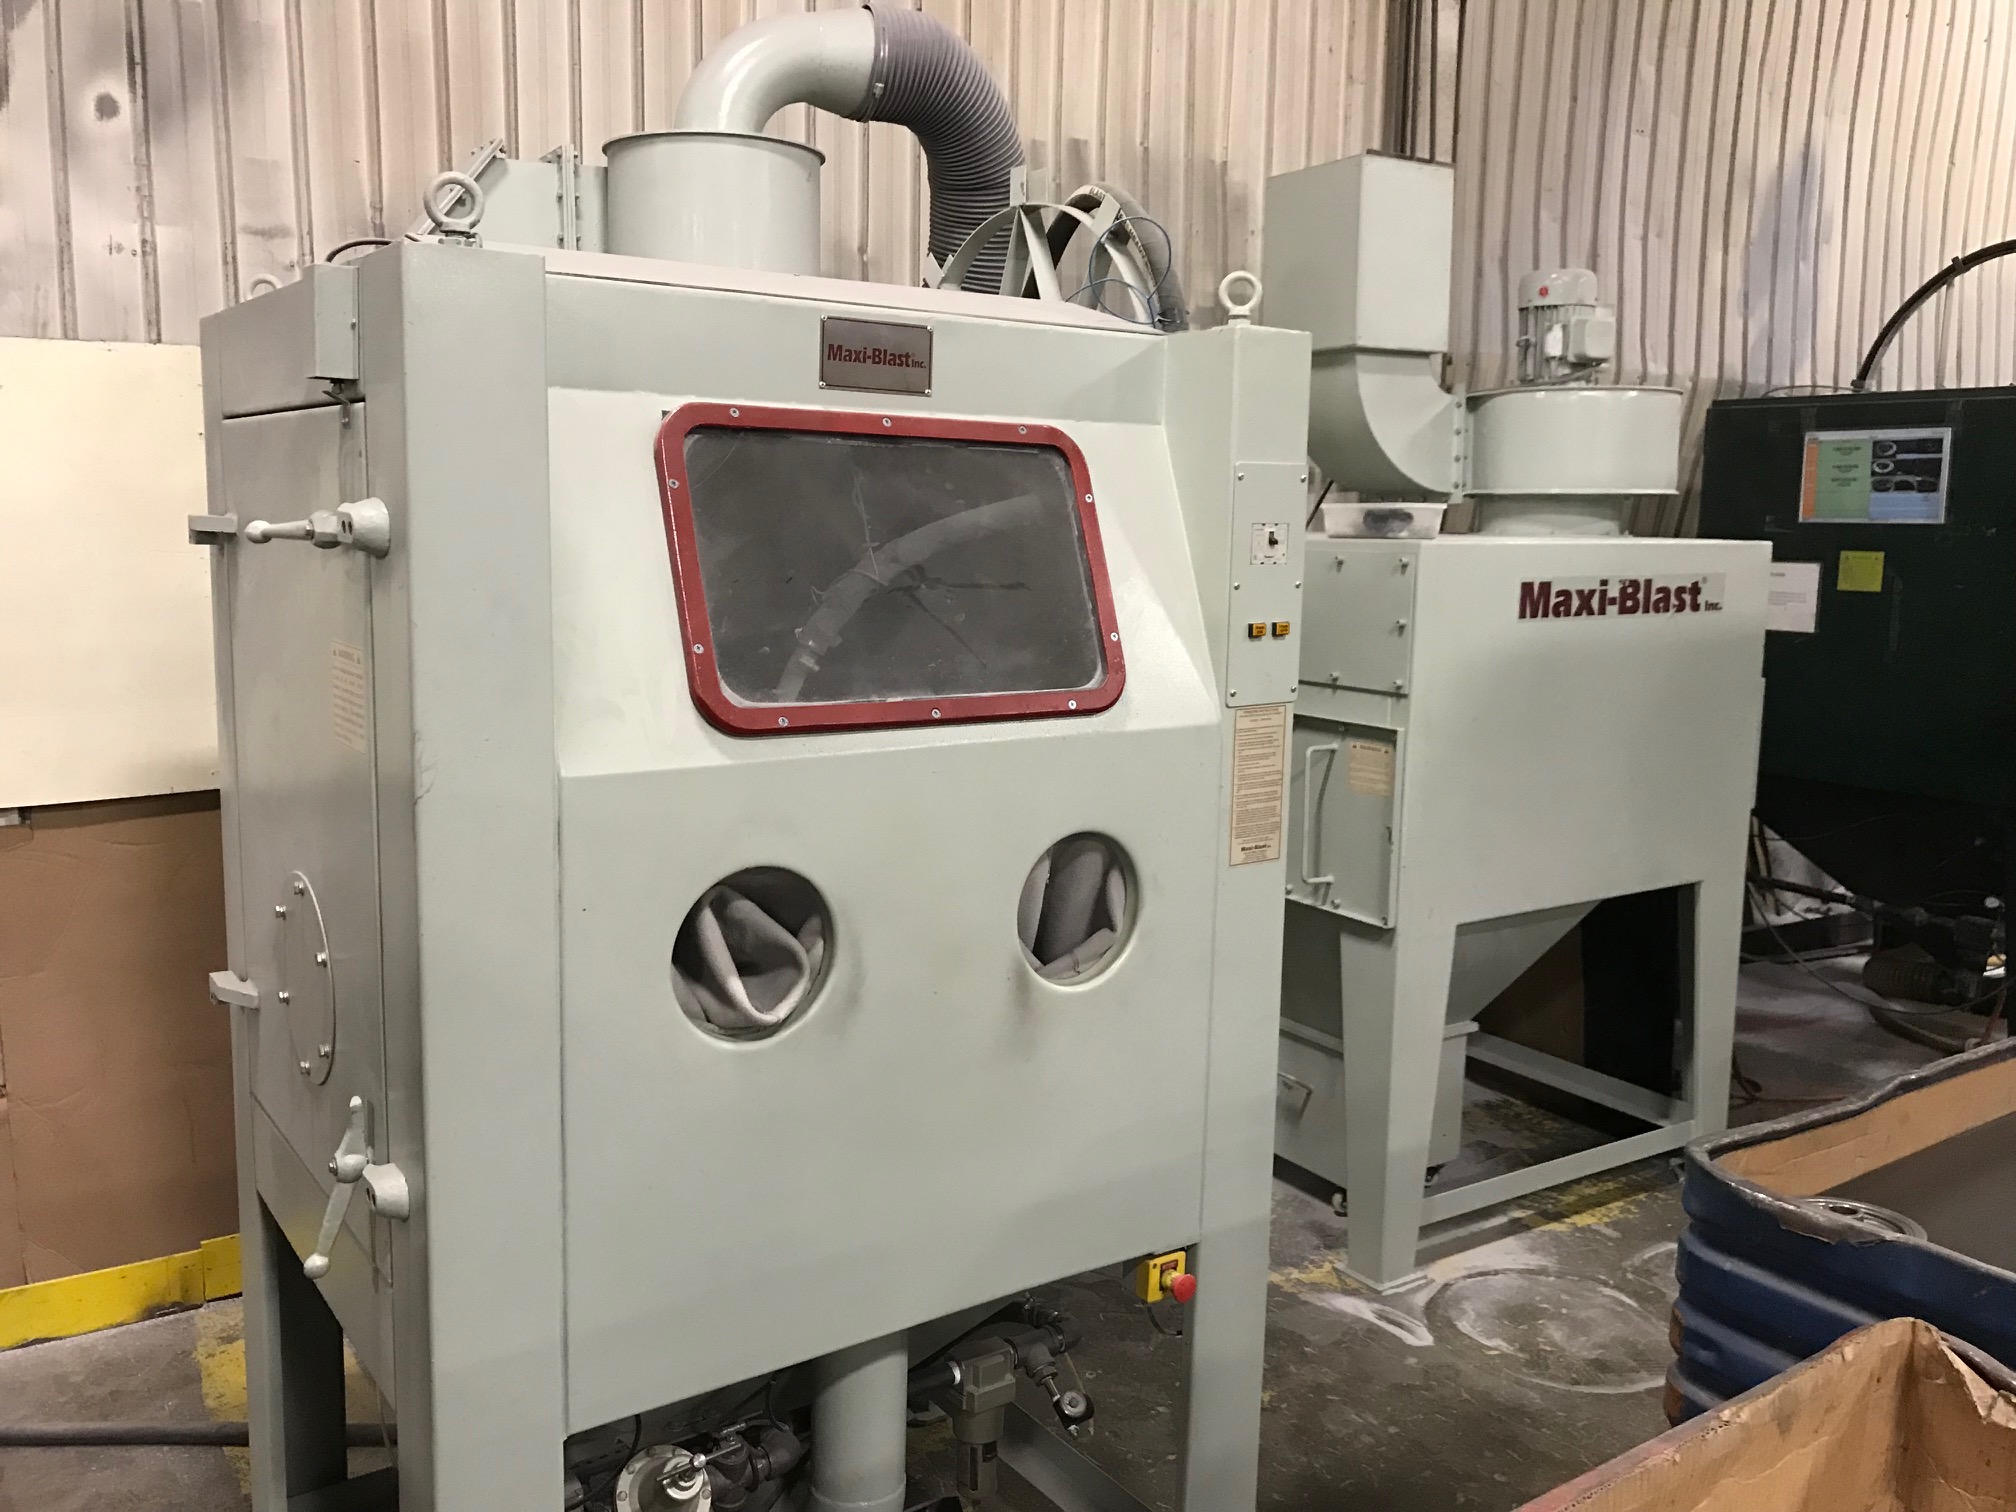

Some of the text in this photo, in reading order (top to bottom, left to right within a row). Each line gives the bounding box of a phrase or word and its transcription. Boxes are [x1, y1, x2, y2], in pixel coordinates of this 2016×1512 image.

[827, 344, 911, 368] Maxi-Blast
[1518, 578, 1723, 619] Maxi-Blast Inc.
